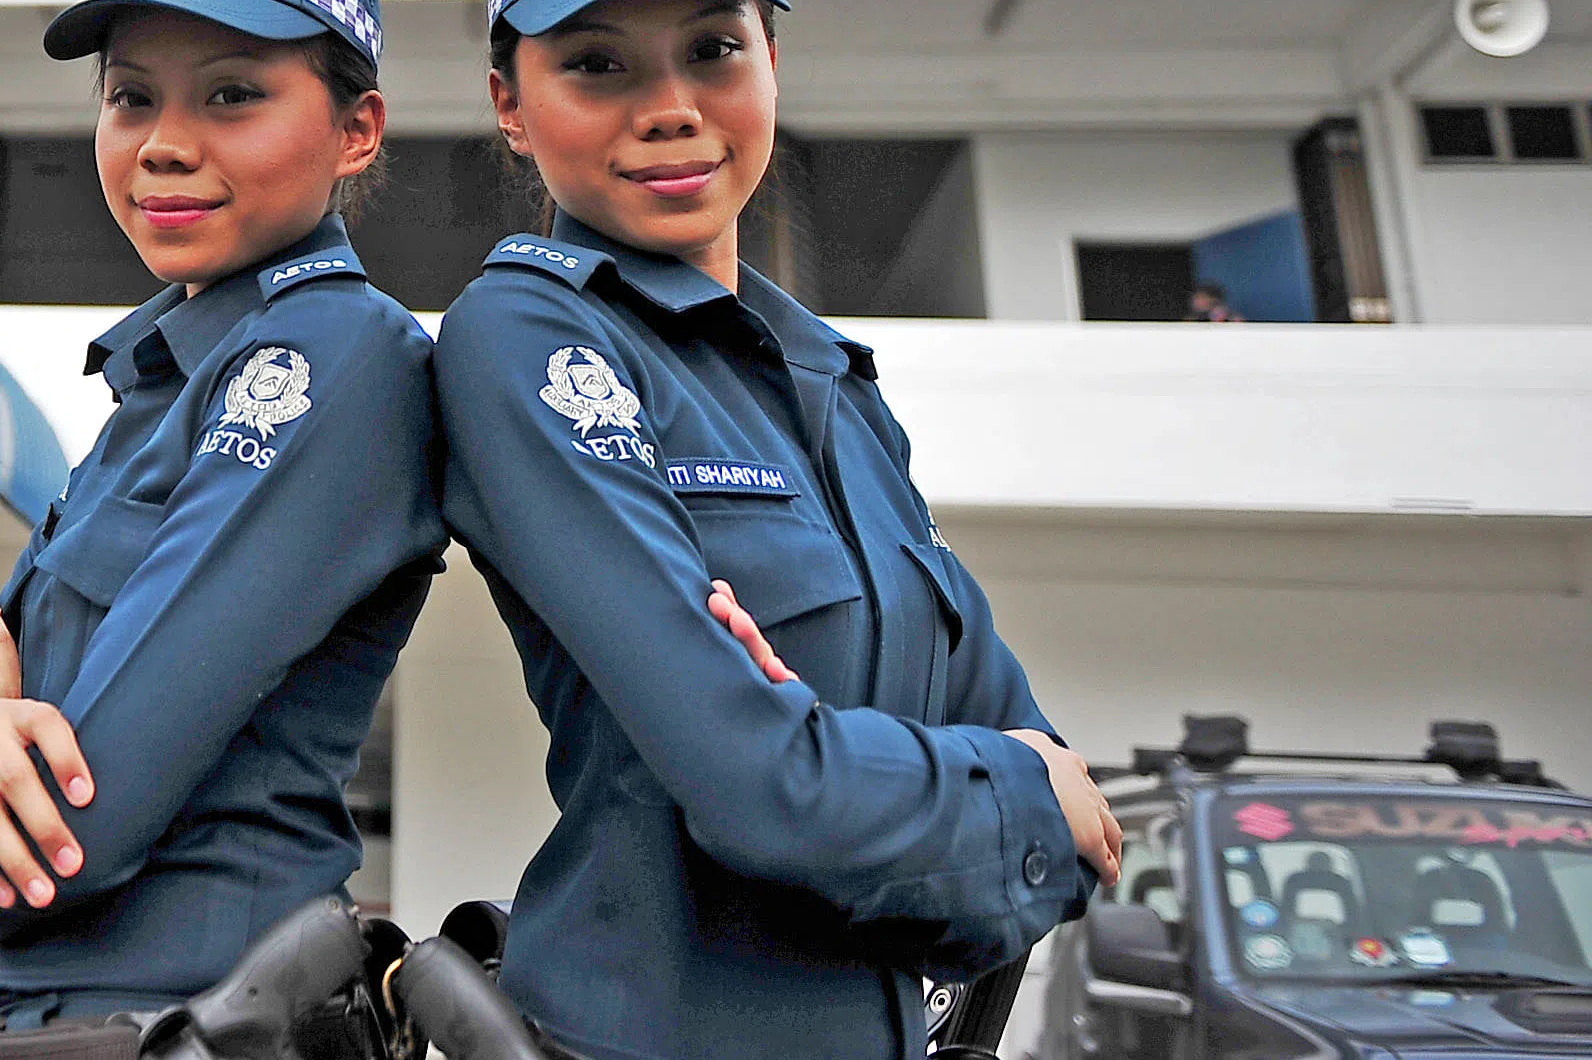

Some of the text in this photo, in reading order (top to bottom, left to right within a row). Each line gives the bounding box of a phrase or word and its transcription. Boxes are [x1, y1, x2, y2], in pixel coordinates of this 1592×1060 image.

[499, 241, 580, 270] AETOS
[271, 259, 348, 285] AETOS
[196, 429, 278, 470] AETOS
[694, 464, 787, 489] SHARIYAH
